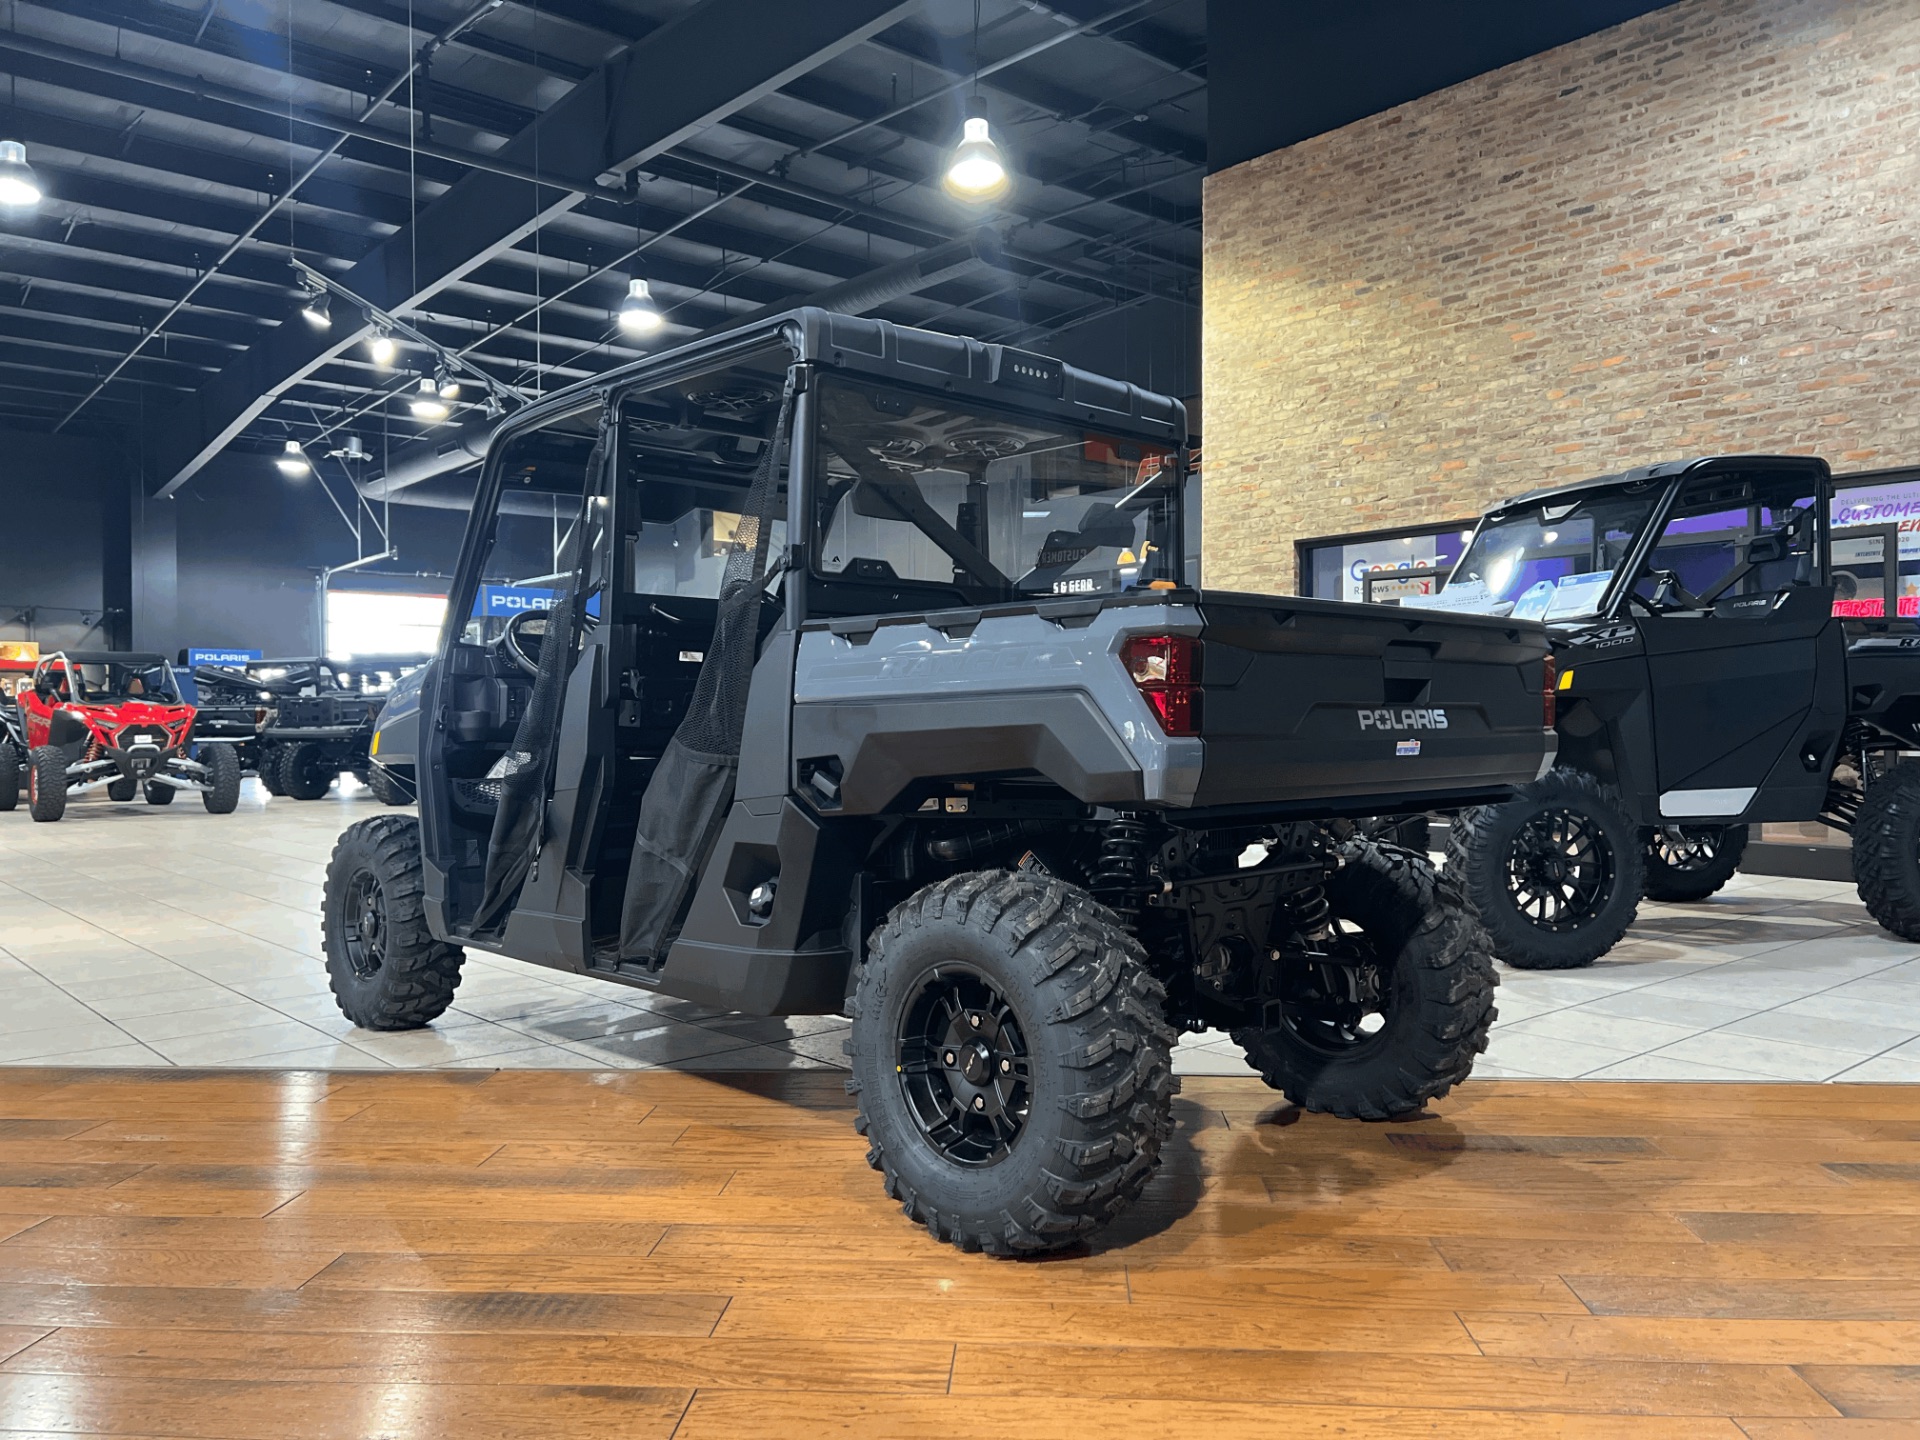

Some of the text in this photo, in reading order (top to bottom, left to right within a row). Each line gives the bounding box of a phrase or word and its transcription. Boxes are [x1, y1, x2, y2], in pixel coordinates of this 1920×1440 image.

[1841, 496, 1884, 506] DELIVERING
[1580, 624, 1634, 644] XP
[1595, 636, 1634, 649] 1000
[195, 653, 250, 662] POLARIS
[1357, 709, 1448, 730] POLARIS
